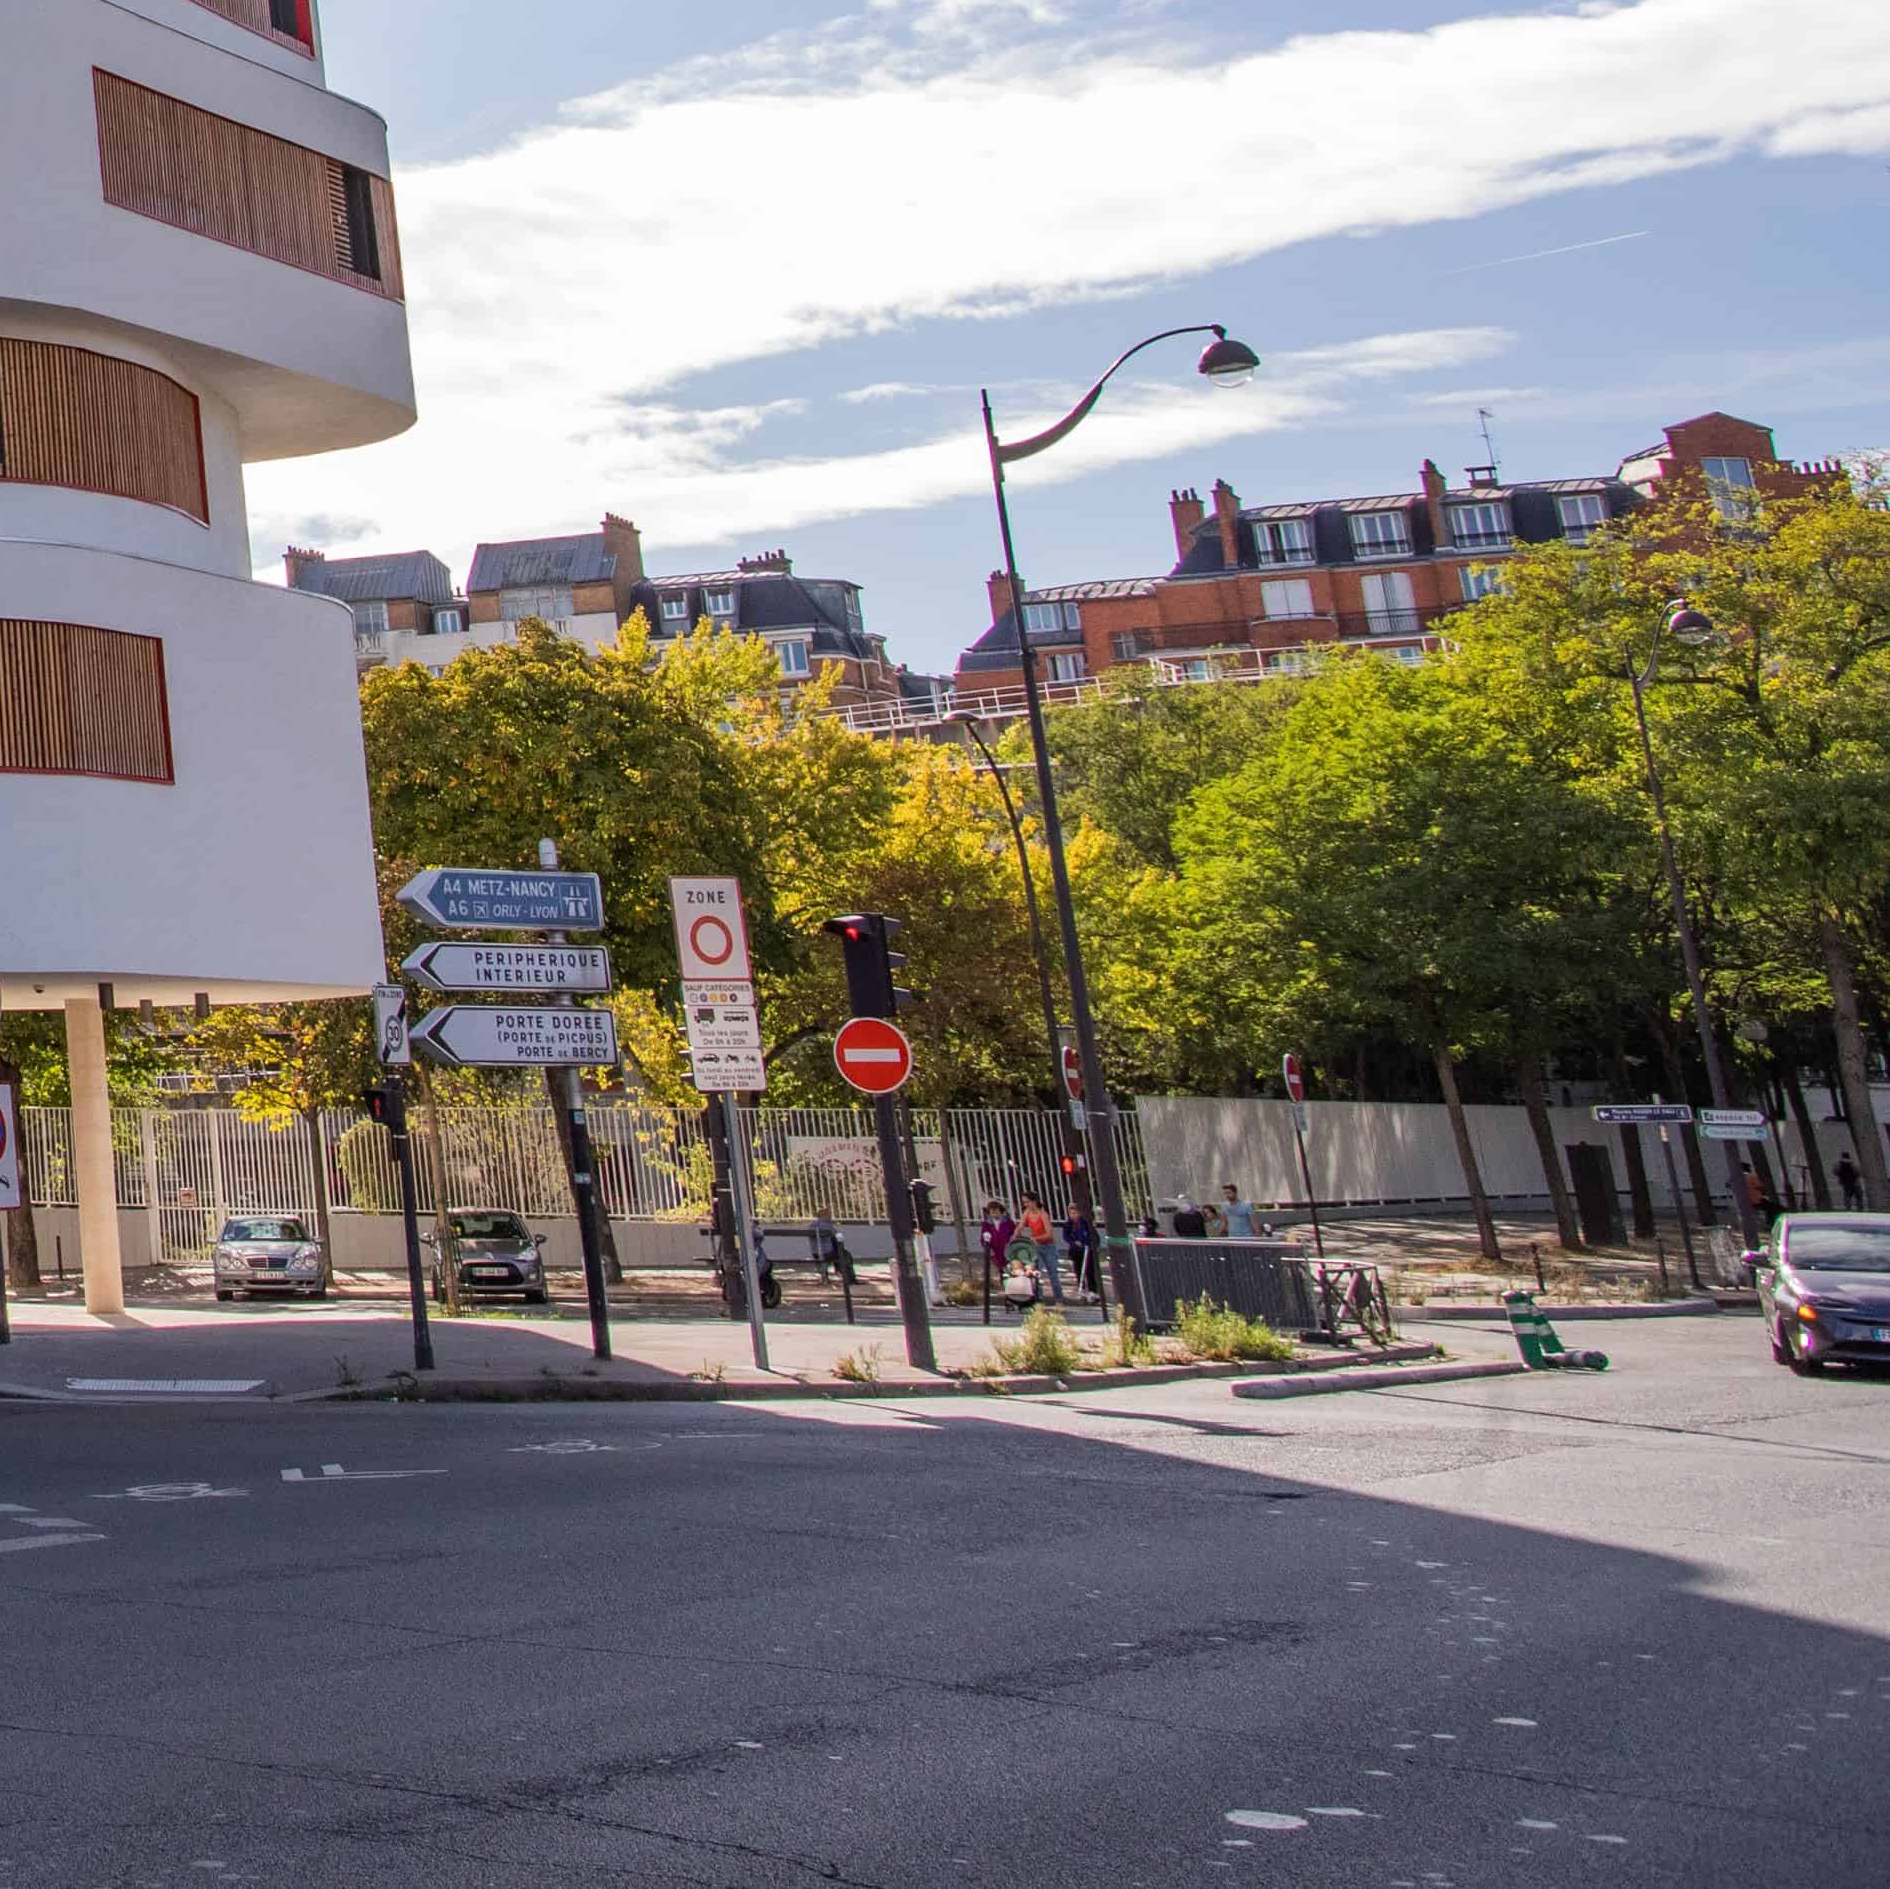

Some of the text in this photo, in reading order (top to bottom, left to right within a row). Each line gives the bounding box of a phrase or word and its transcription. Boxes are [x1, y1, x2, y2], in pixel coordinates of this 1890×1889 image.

[443, 878, 556, 898] A4 METZ-NANCY
[686, 890, 726, 904] ZONE
[448, 900, 469, 917] A6
[474, 952, 600, 968] PERIPHERIQUE
[476, 968, 567, 983] INTERIEUR
[496, 1014, 604, 1030] PORTE DOREE
[388, 1025, 400, 1042] 30
[497, 1031, 542, 1044] (PORTE
[558, 1032, 608, 1045] PICPUS)
[517, 1046, 554, 1058] PORTE
[572, 1047, 609, 1059] BERCY
